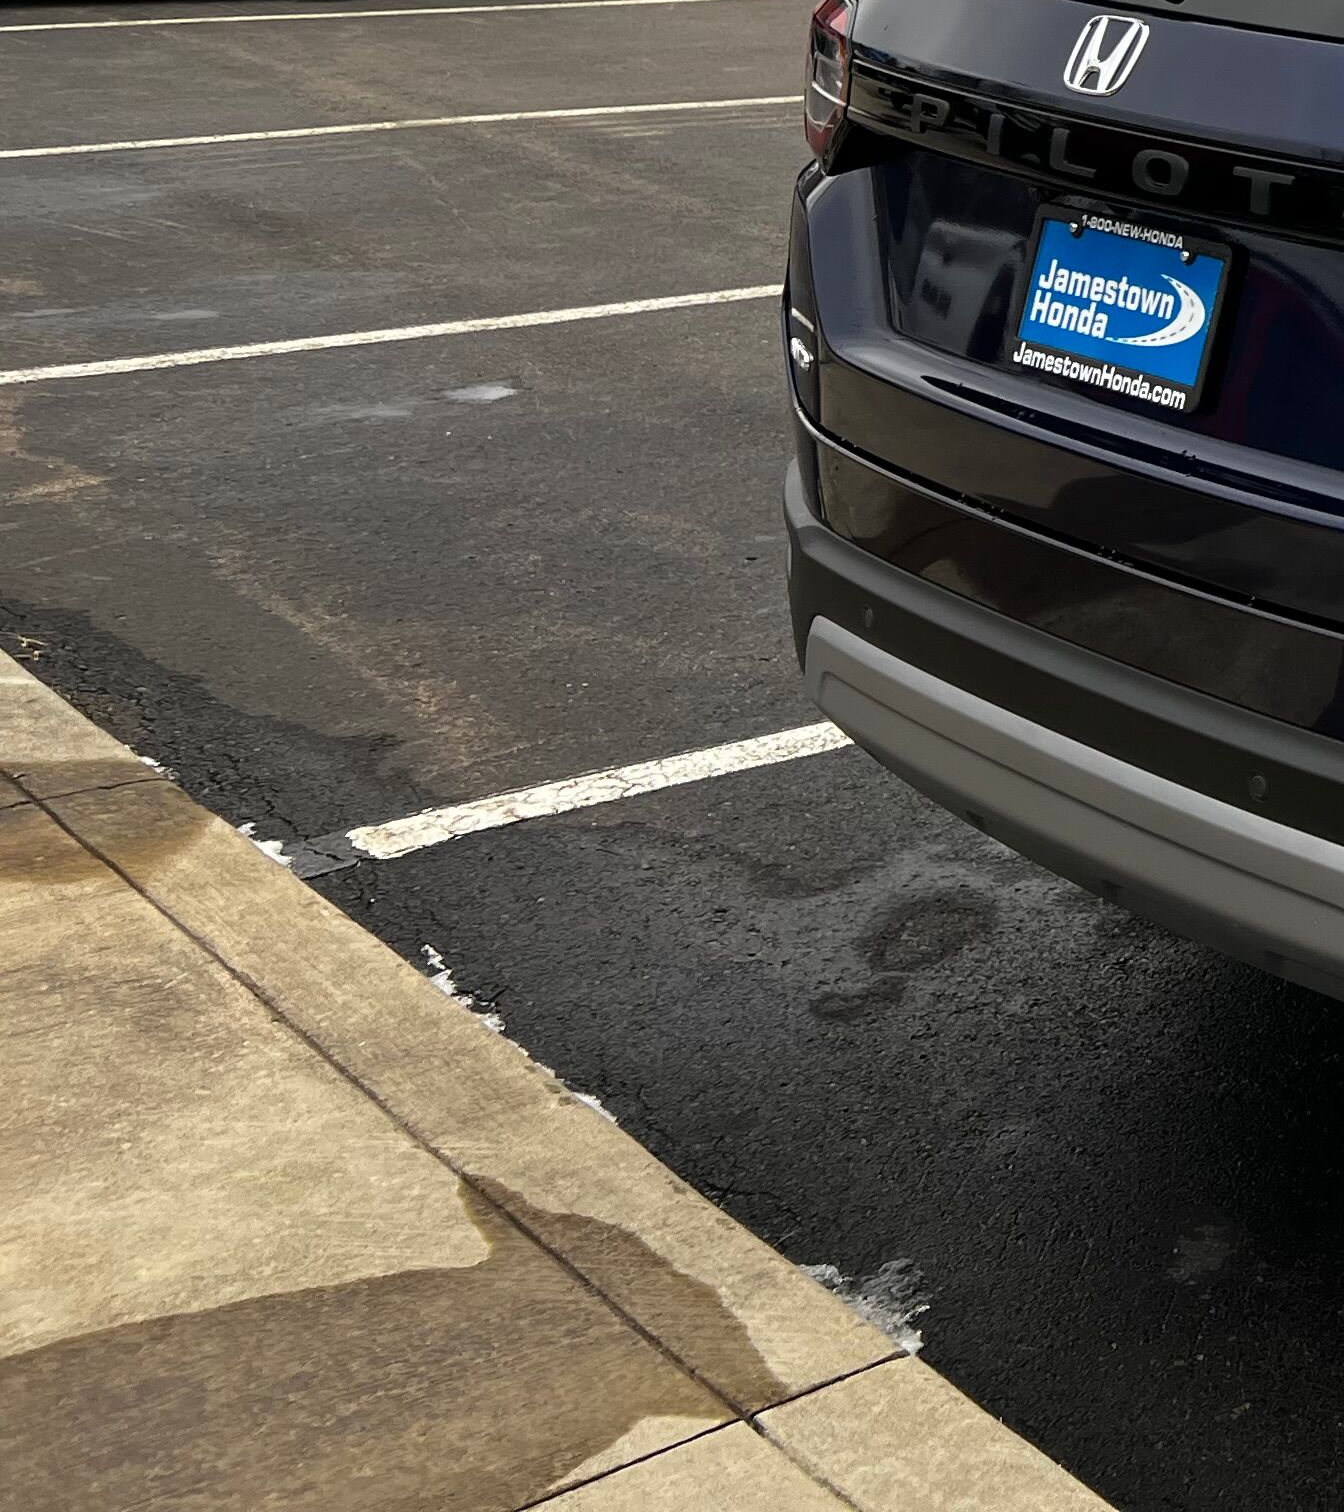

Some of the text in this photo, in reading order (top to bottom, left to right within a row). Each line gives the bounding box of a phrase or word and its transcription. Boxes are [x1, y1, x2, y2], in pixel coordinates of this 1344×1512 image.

[910, 94, 1295, 215] PILOT
[1081, 214, 1184, 249] 1-800-NEW-HONDA
[1030, 290, 1108, 338] Honda
[1039, 259, 1175, 320] Jamestown
[1013, 342, 1186, 410] JamestownHonda.com
